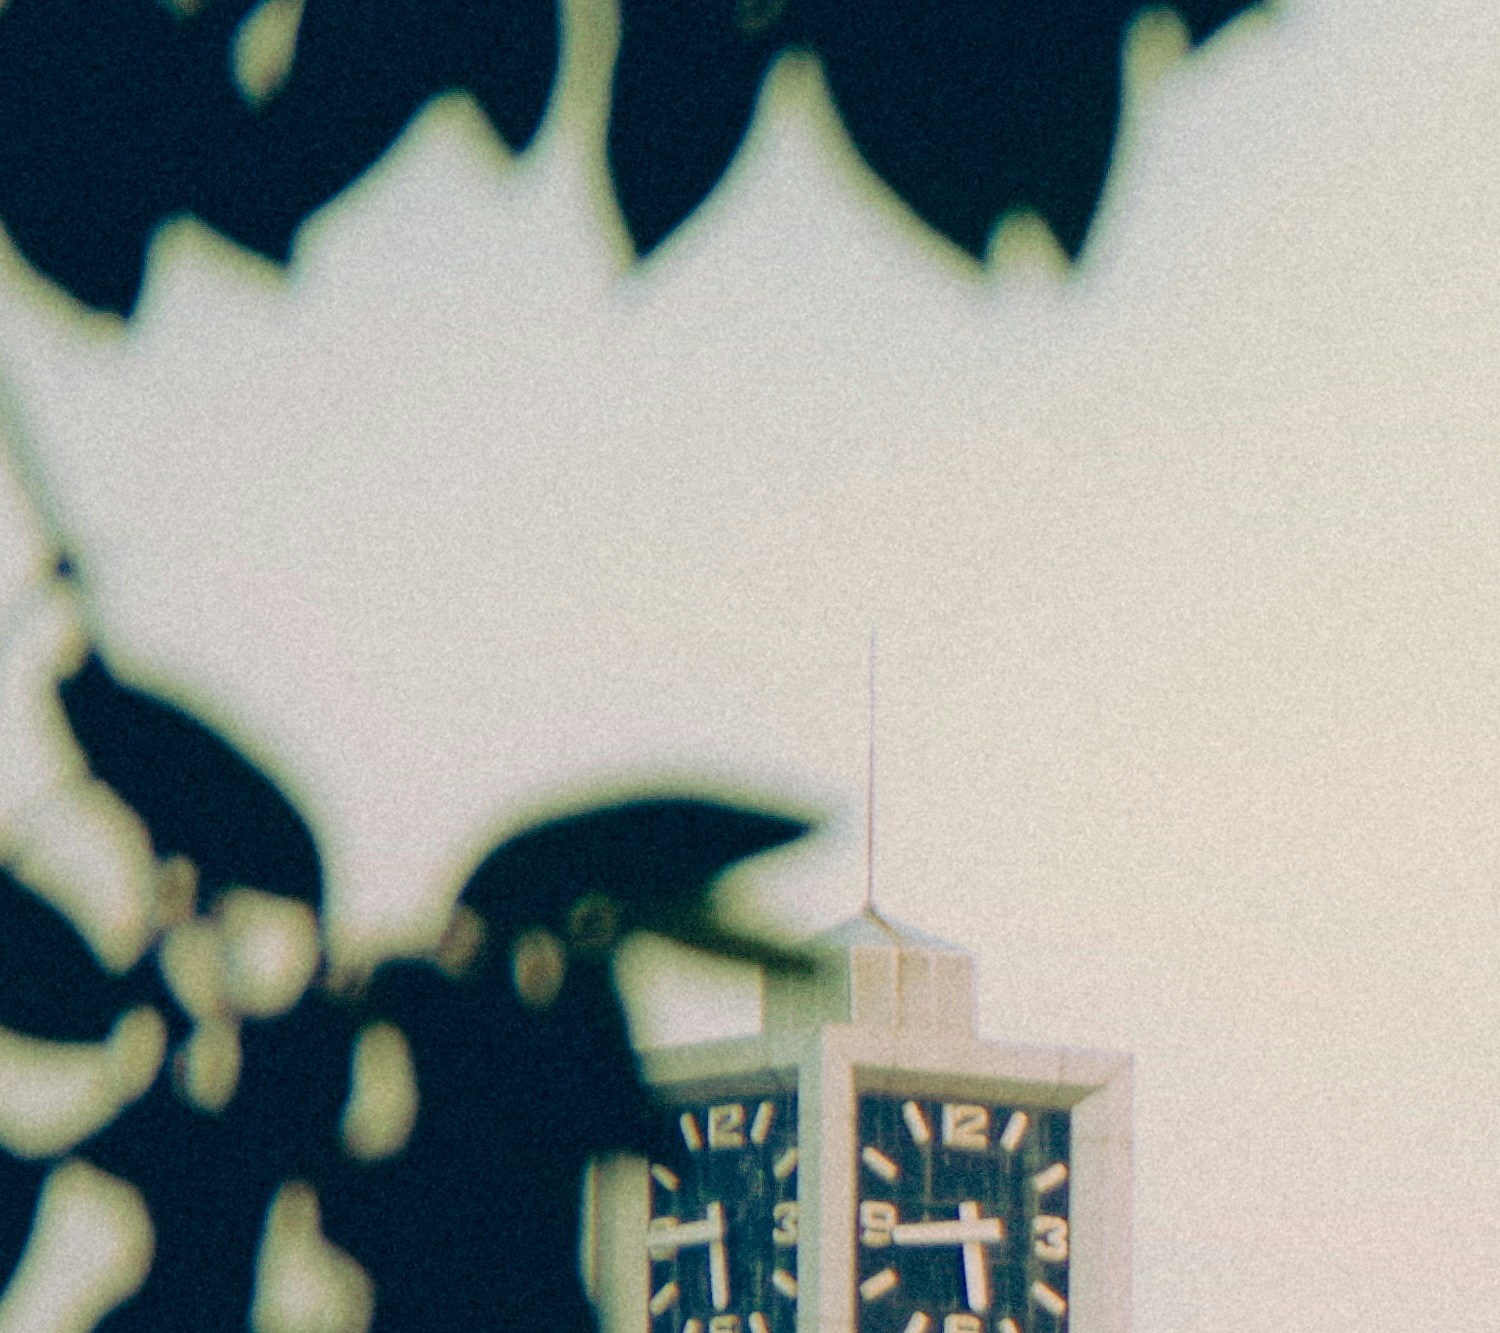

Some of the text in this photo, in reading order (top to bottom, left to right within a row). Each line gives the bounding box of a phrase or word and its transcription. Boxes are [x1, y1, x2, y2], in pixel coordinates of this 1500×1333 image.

[708, 1104, 746, 1149] 12
[942, 1104, 989, 1151] 12
[773, 1201, 798, 1247] 3
[859, 1201, 898, 1247] 9
[1034, 1215, 1069, 1262] 3
